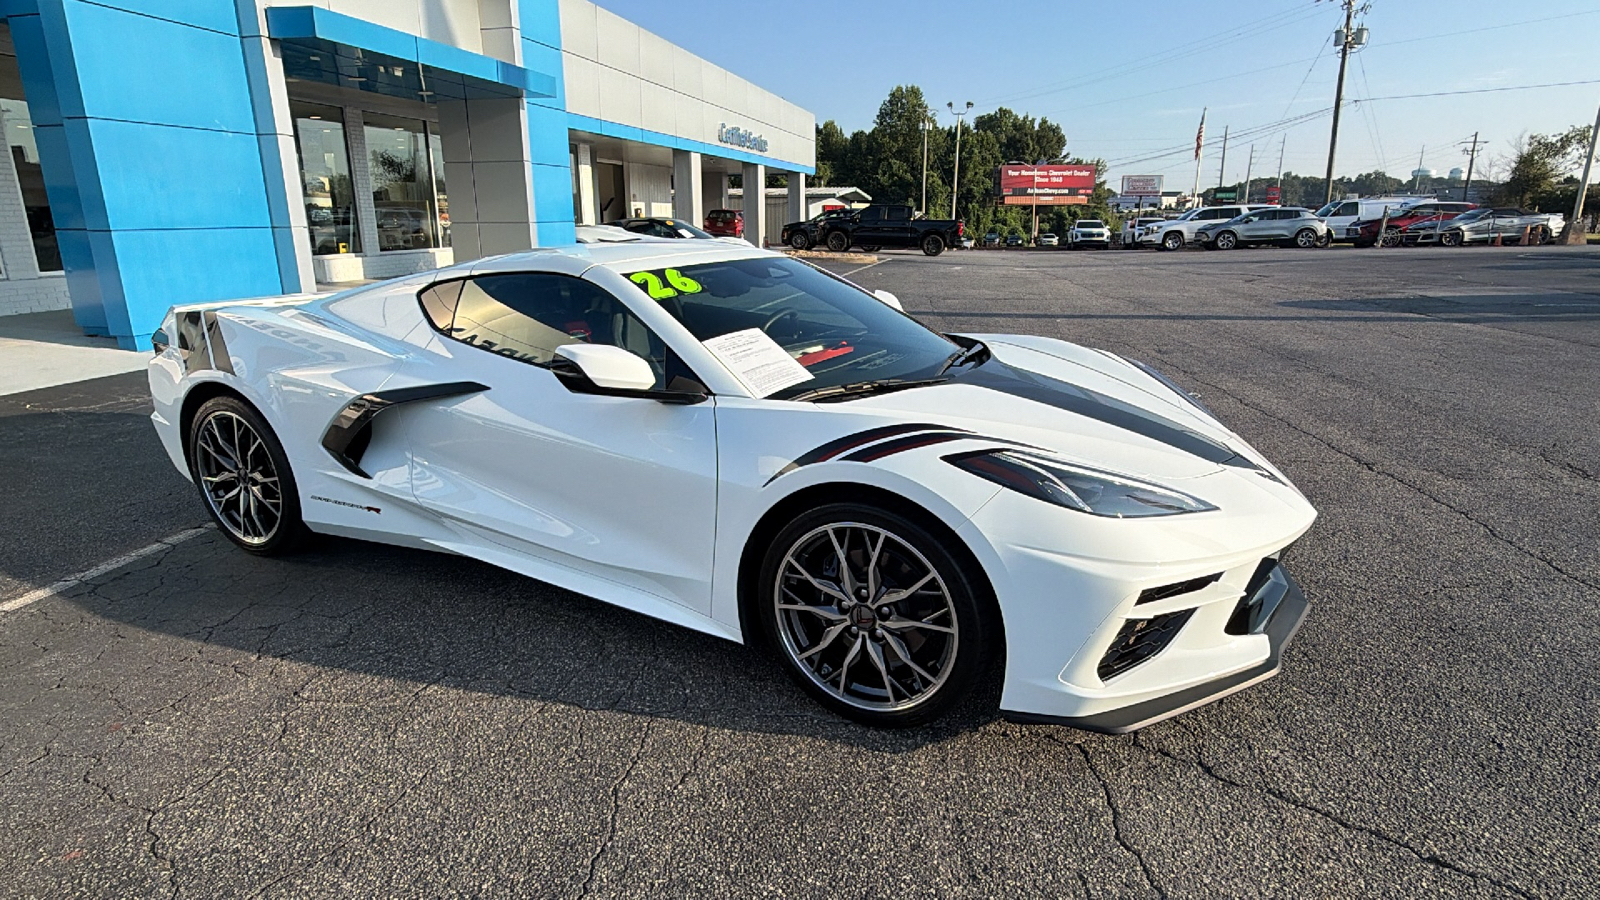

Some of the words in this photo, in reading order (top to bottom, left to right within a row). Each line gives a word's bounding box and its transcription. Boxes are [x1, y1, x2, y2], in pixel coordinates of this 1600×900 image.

[718, 123, 747, 148] Certified
[746, 131, 769, 152] Service
[1007, 169, 1020, 177] Your
[1073, 169, 1091, 177] Dealer
[629, 268, 703, 300] 26
